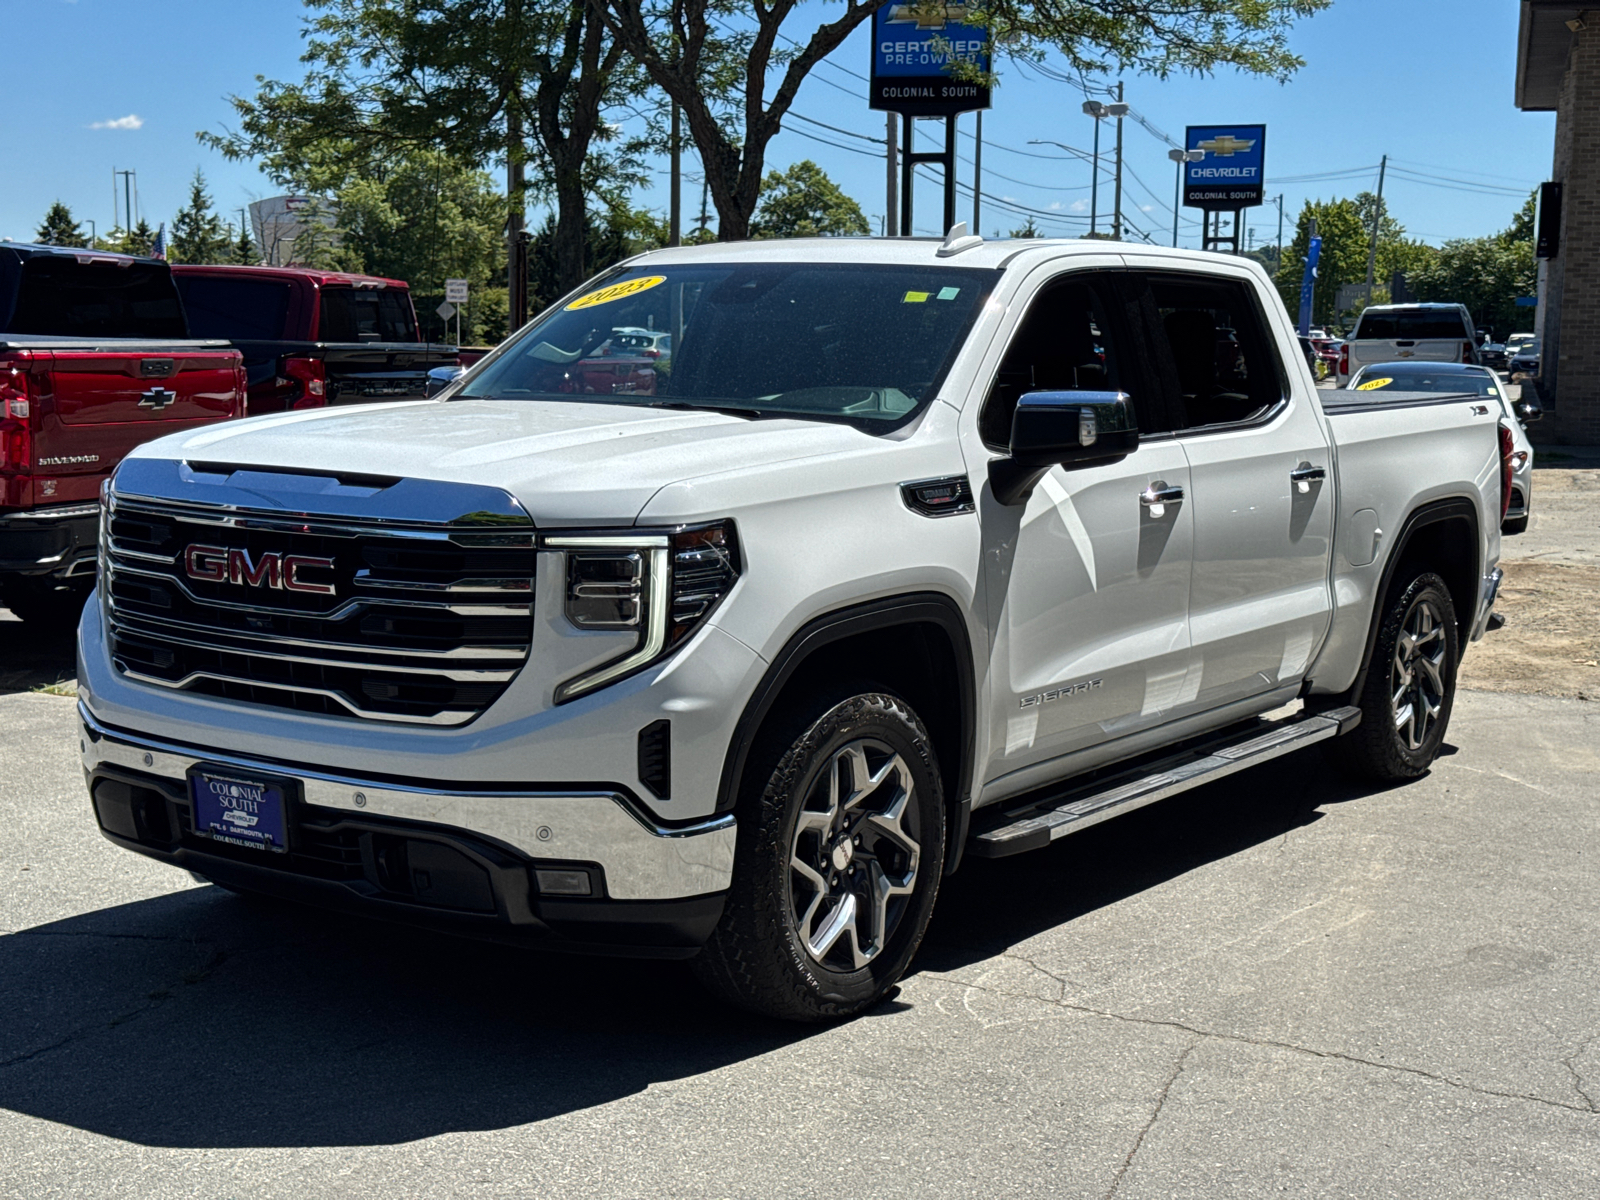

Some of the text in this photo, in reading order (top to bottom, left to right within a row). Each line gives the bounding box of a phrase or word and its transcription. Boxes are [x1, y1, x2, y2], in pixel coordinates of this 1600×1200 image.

[882, 86, 977, 98] COLONIAL SOUTH
[1191, 167, 1257, 177] CHEVROLET
[1189, 191, 1257, 200] COLONIAL SOUTH
[577, 278, 653, 308] 2023
[184, 543, 336, 595] GMC
[1020, 678, 1104, 710] SIERRA
[210, 782, 266, 802] COLONIAL
[219, 796, 258, 813] SOUTH
